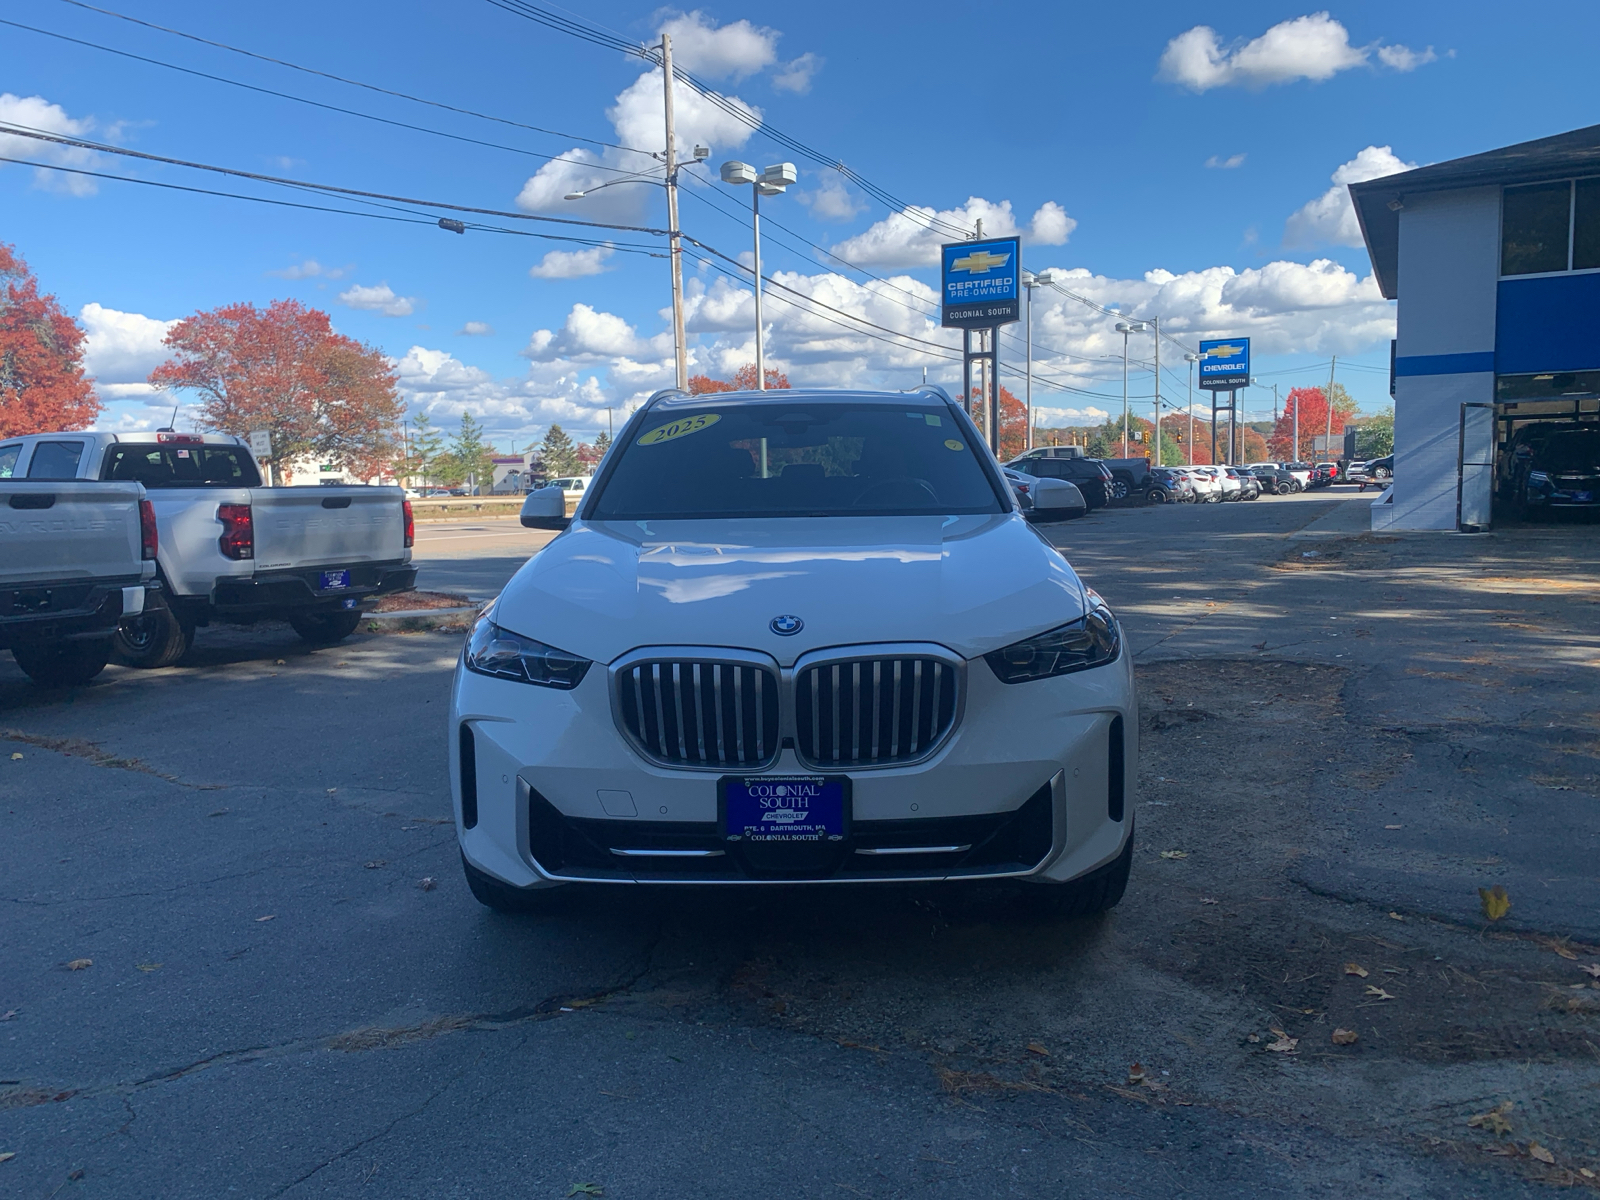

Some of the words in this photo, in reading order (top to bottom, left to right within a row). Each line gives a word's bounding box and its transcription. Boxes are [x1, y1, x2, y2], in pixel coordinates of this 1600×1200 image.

[948, 277, 1012, 291] CERTIFIED
[951, 286, 1009, 298] PRE-OWNED
[950, 310, 984, 319] COLONIAL
[988, 307, 1011, 316] SOUTH
[1203, 363, 1246, 371] CHEVROLET
[653, 416, 706, 442] 2025
[748, 785, 820, 797] COLONIAL
[759, 797, 808, 808] SOUTH
